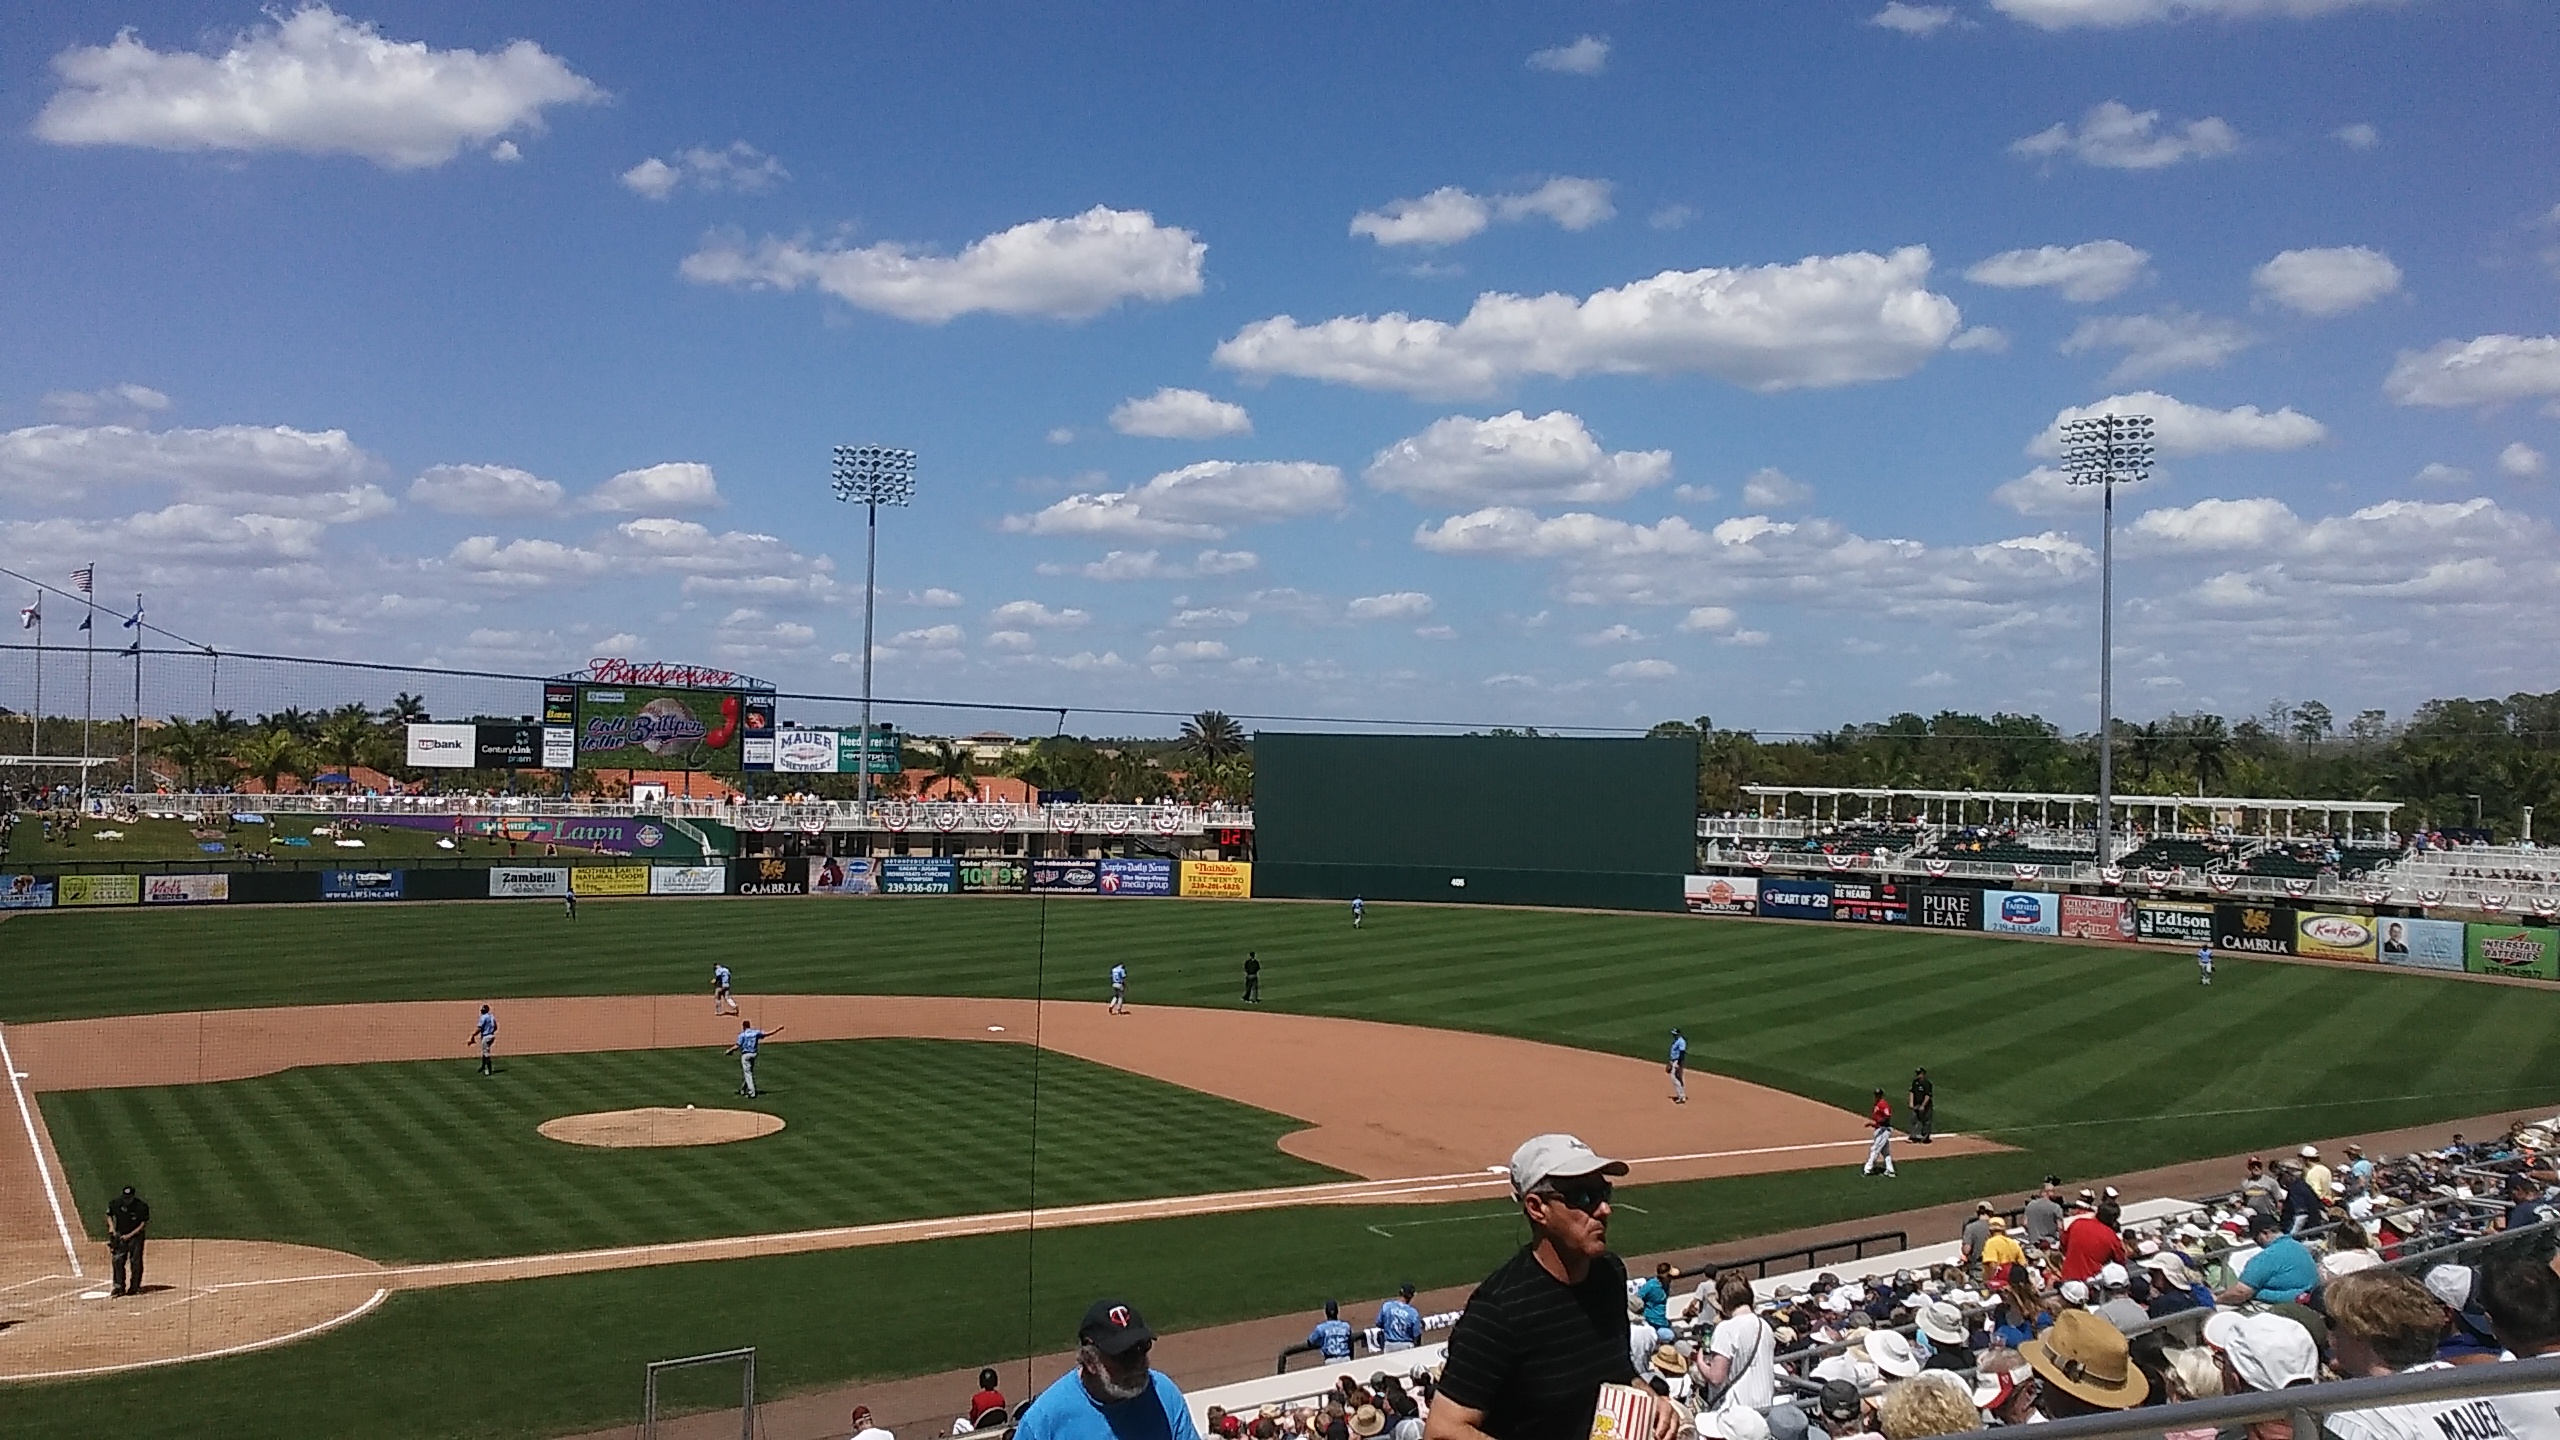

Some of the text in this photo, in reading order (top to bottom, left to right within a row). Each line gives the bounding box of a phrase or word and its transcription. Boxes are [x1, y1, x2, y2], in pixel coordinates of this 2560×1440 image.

[589, 658, 733, 686] Budweiser
[628, 716, 707, 744] Bullpen
[780, 733, 832, 750] MAUER
[481, 744, 532, 755] CenturyLink
[508, 755, 532, 764] prism
[780, 756, 832, 771] CHEVROLET
[553, 820, 622, 840] Lawn
[982, 860, 1012, 868] Country
[1101, 862, 1170, 872] Naples Daily News
[502, 872, 556, 884] Zambelli
[1134, 874, 1168, 882] News-Press
[740, 883, 801, 894] CAMBRIA
[887, 883, 949, 892] 239-936-6778
[1146, 882, 1168, 890] group
[1774, 893, 1800, 905] HEART
[1801, 894, 1811, 906] OF
[1812, 894, 1828, 907] 29
[1834, 888, 1844, 898] BE
[1846, 890, 1872, 900] HEARD
[1922, 895, 1970, 912] PURE
[2006, 902, 2039, 912] FAIRFIELD
[2155, 912, 2211, 928] Edison
[2156, 926, 2212, 936] NATIONAL BANK
[2222, 934, 2288, 954] CAMBRIA
[2482, 940, 2542, 952] INTERSTATE
[2484, 949, 2540, 961] BATTERIES
[2432, 1400, 2504, 1440] MAUER
